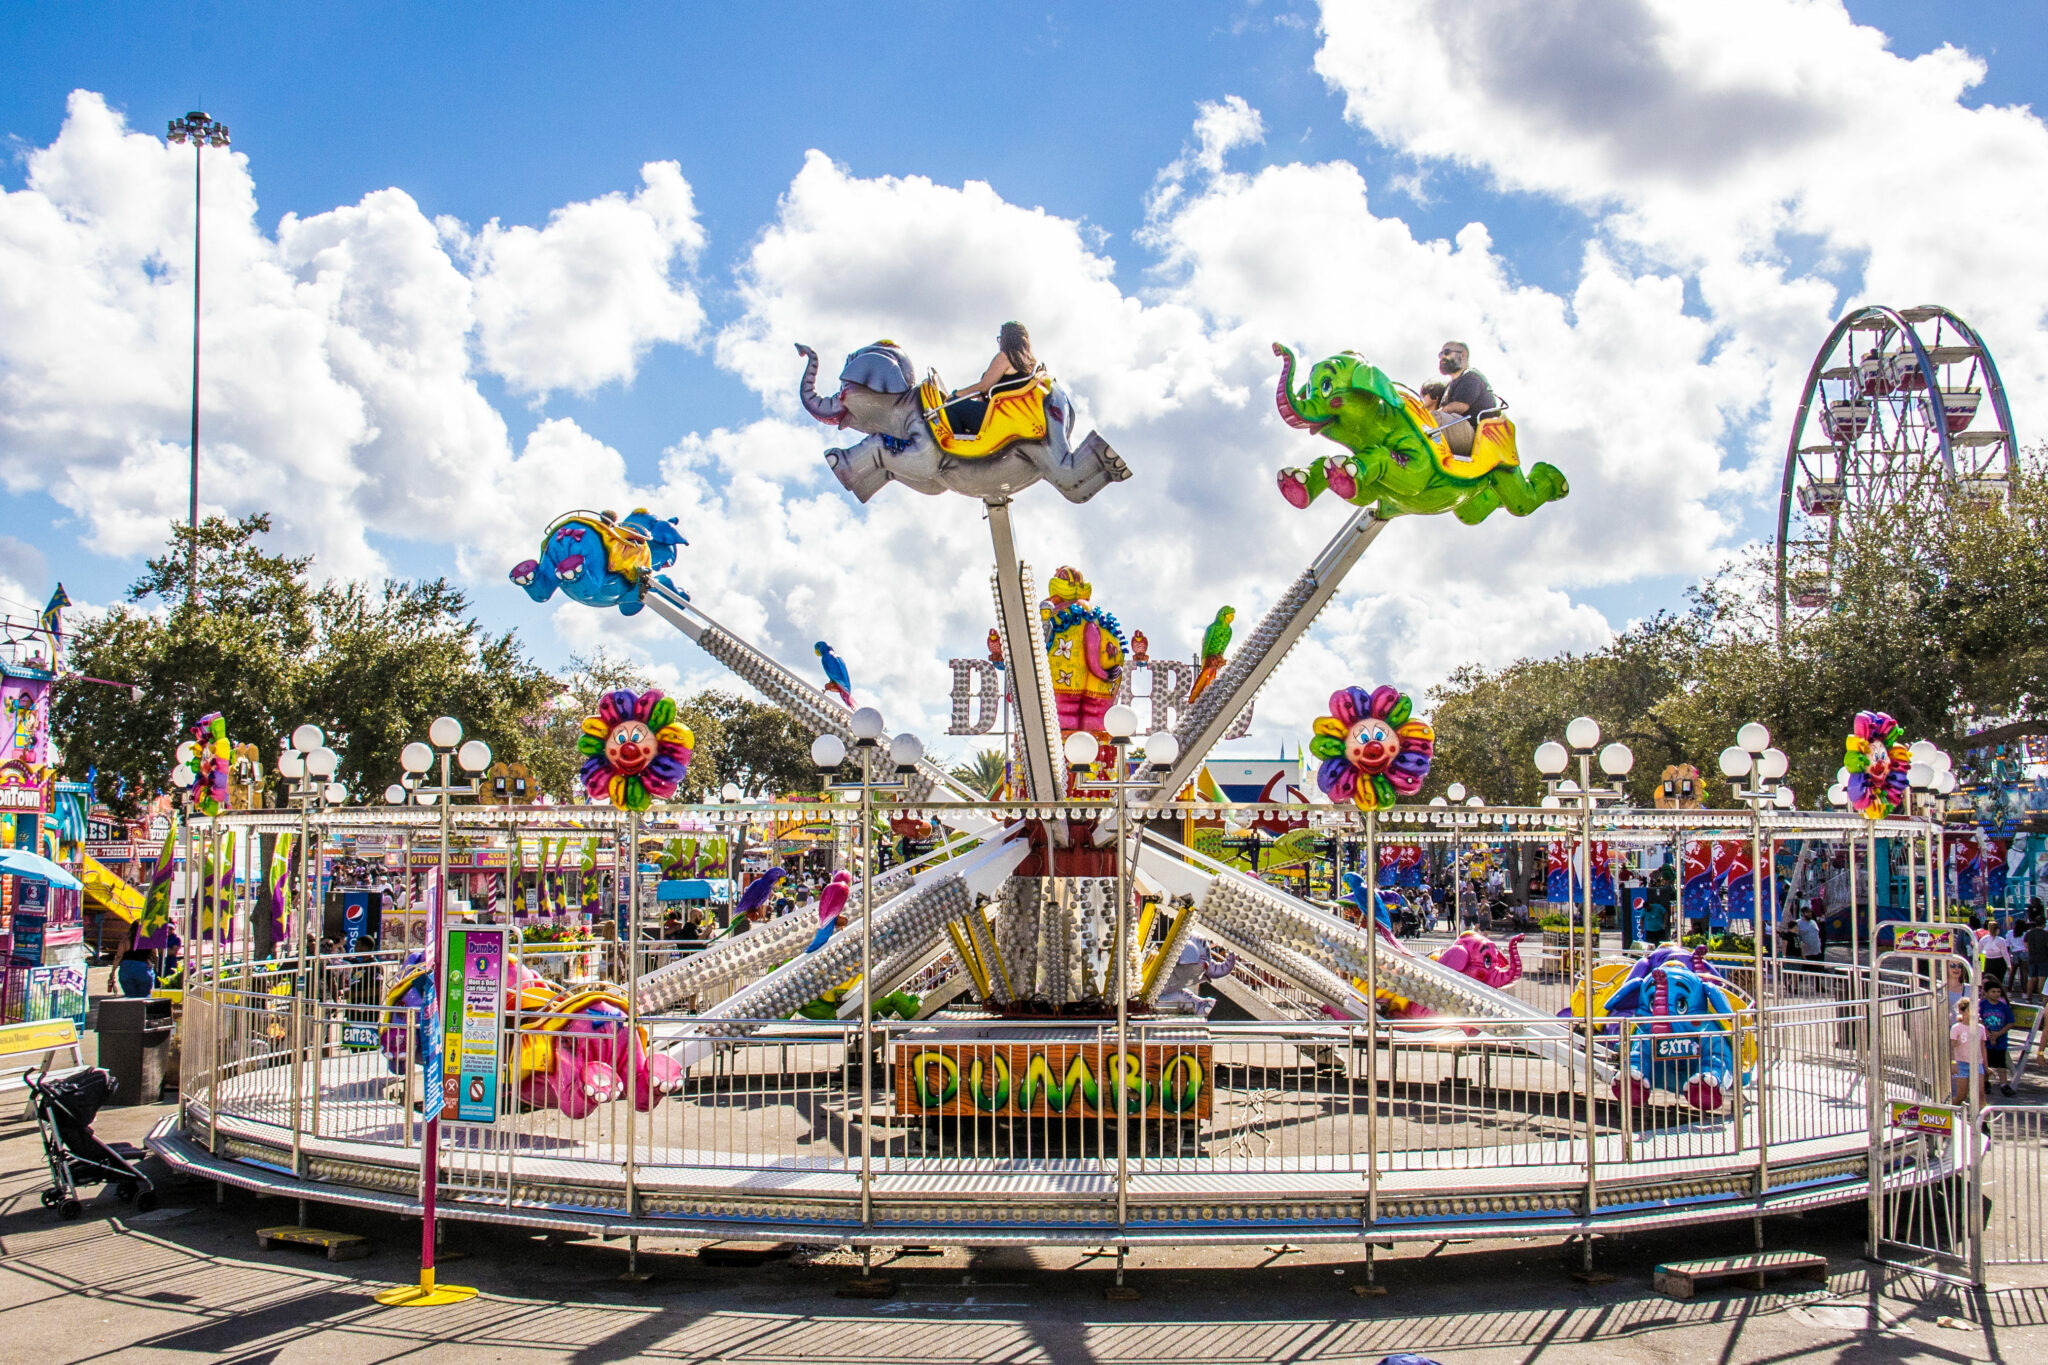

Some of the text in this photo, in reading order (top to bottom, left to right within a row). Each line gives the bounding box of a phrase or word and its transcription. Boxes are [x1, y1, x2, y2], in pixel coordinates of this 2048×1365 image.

[410, 855, 439, 864] OTTON
[446, 855, 471, 864] ANDY
[29, 886, 38, 898] 3
[468, 941, 499, 955] Dumbo
[480, 959, 486, 970] 3
[343, 1028, 373, 1045] ENTER
[1659, 1039, 1691, 1056] EXIT
[912, 1050, 1205, 1115] DUMBO
[1922, 1113, 1947, 1126] ONLY
